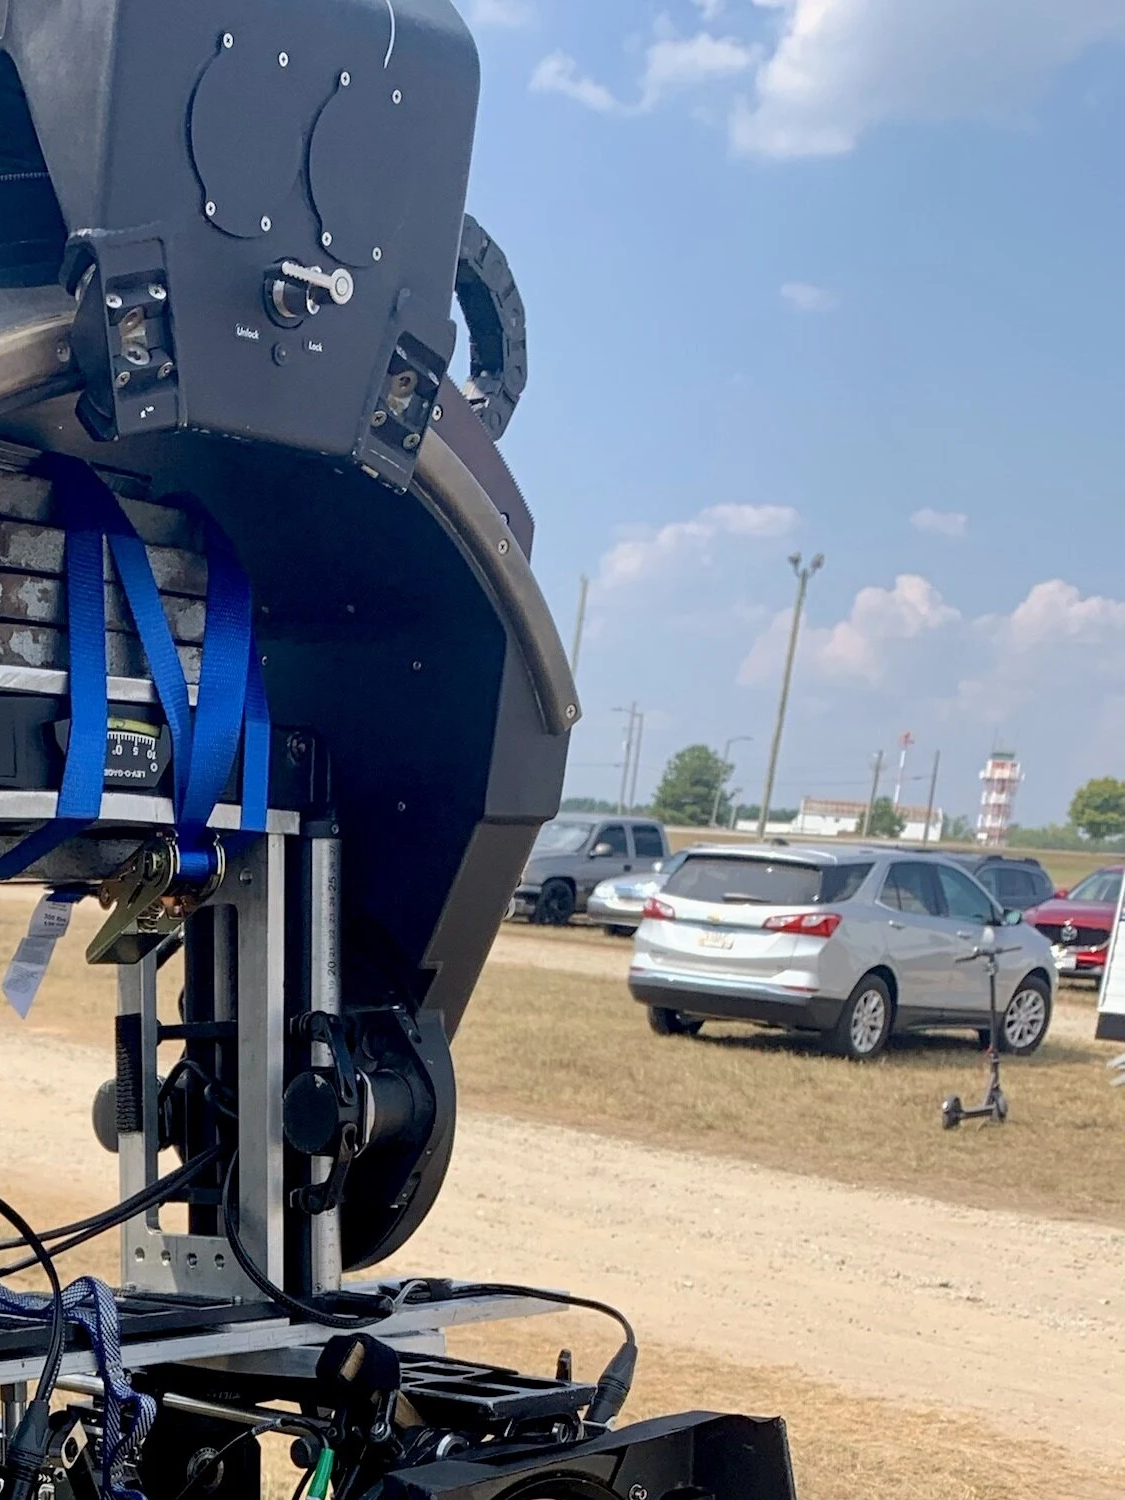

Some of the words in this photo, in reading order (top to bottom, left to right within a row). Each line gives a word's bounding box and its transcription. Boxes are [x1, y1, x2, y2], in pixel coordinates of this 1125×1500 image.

[236, 326, 259, 339] Unlock
[308, 341, 323, 352] Lock
[133, 747, 139, 756] 5
[147, 750, 156, 760] 10
[328, 876, 336, 892] 25
[327, 961, 336, 976] 20
